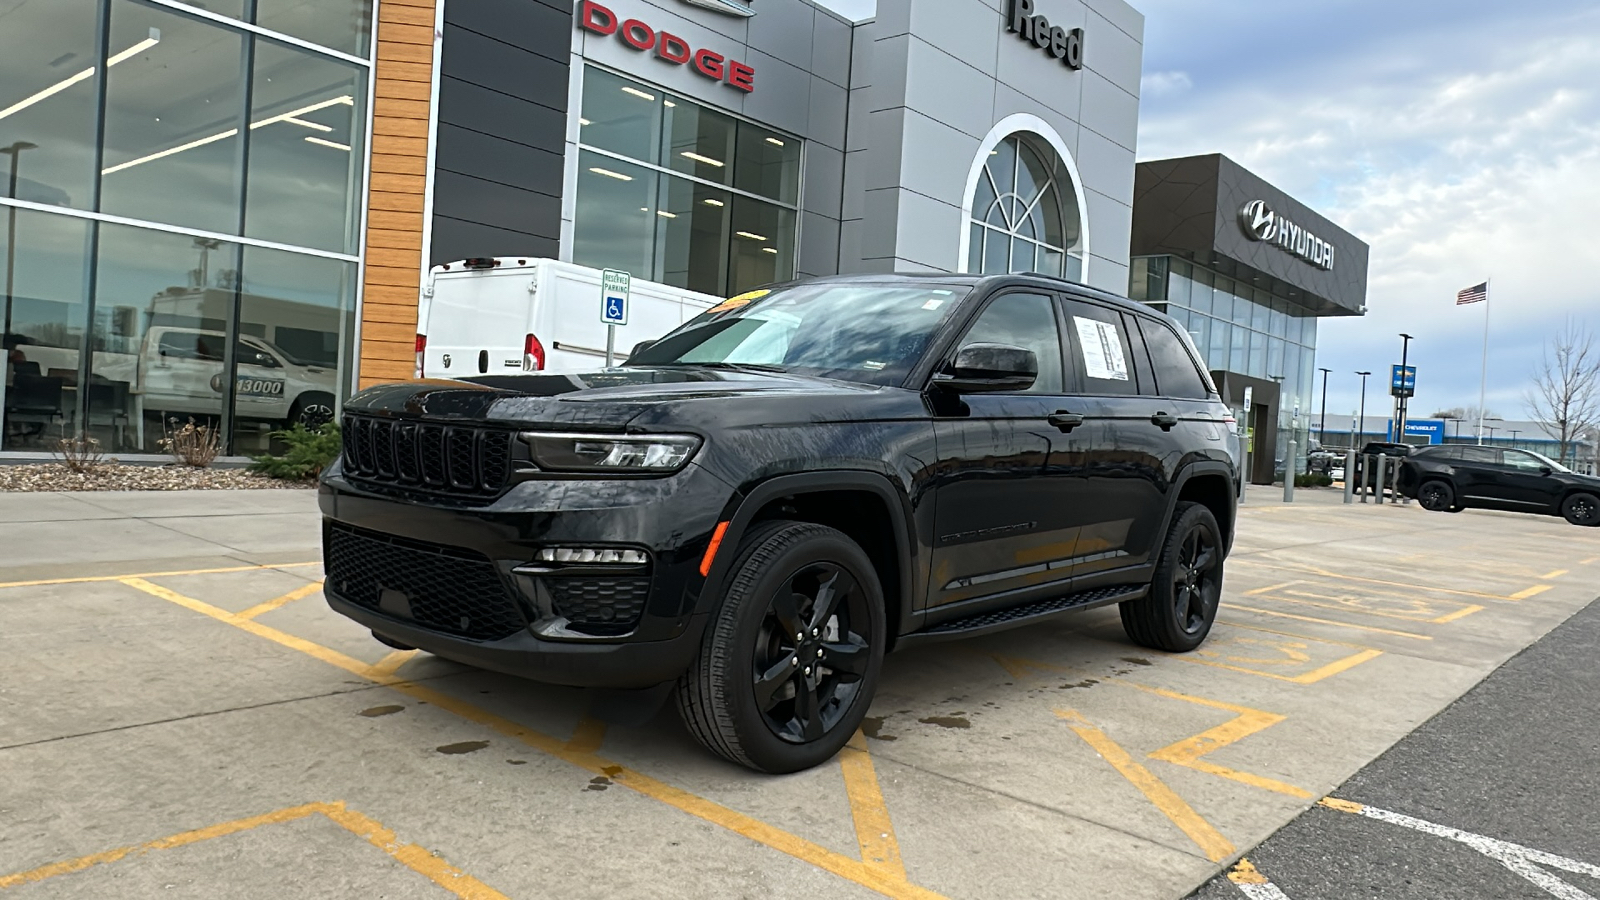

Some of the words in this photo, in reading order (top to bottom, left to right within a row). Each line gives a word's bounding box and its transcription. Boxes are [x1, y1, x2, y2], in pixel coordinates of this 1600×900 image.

[579, 0, 755, 93] DODGE
[1009, 0, 1084, 70] Reed
[1278, 216, 1334, 270] HYUNDAI
[604, 283, 628, 293] PARKING
[605, 274, 628, 285] RESERVED
